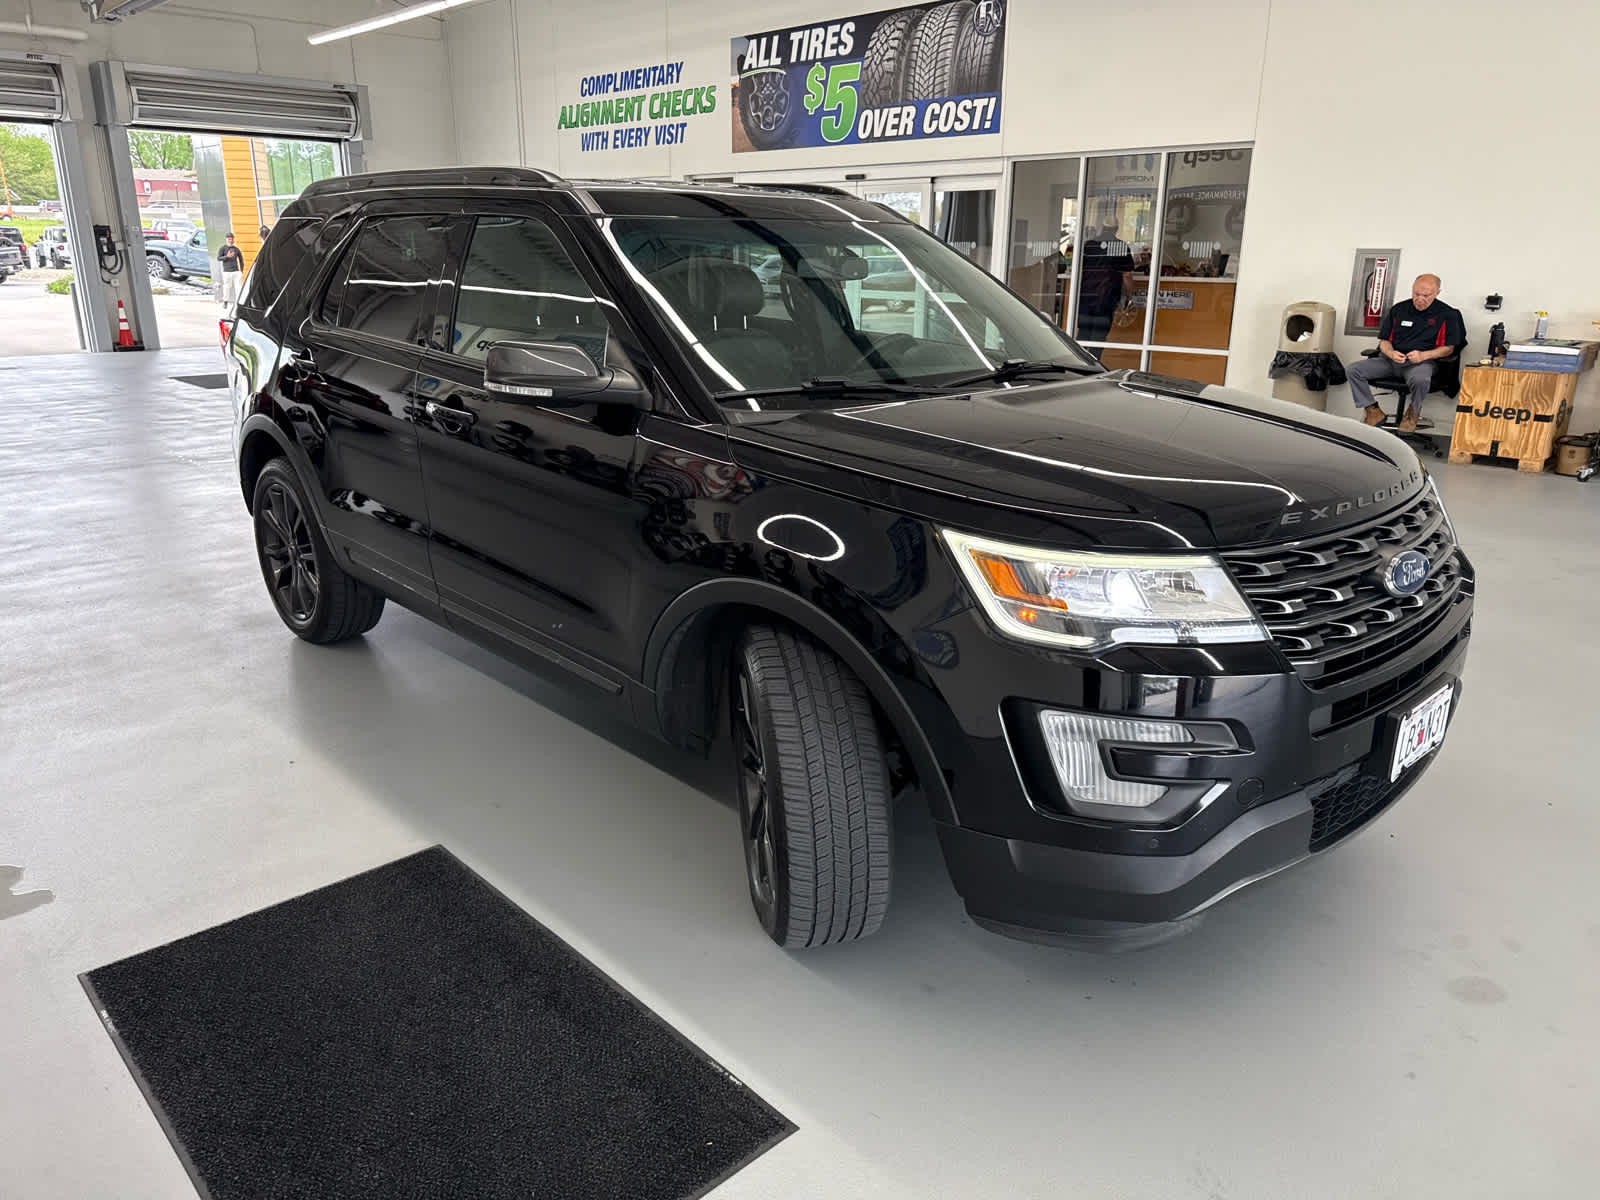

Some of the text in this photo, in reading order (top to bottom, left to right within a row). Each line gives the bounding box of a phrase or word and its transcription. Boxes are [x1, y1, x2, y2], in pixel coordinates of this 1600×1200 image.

[742, 21, 856, 71] ALL TIRES
[580, 61, 684, 97] COMPLIMENTARY
[557, 85, 717, 130] ALIGNMENT CHECKS
[803, 61, 862, 143] $5
[857, 96, 997, 140] OVER COST!
[581, 122, 688, 152] WITH EVERY VISIT
[1474, 400, 1531, 425] Jeep
[1280, 471, 1419, 526] EXPLORER
[1402, 558, 1426, 586] Ford
